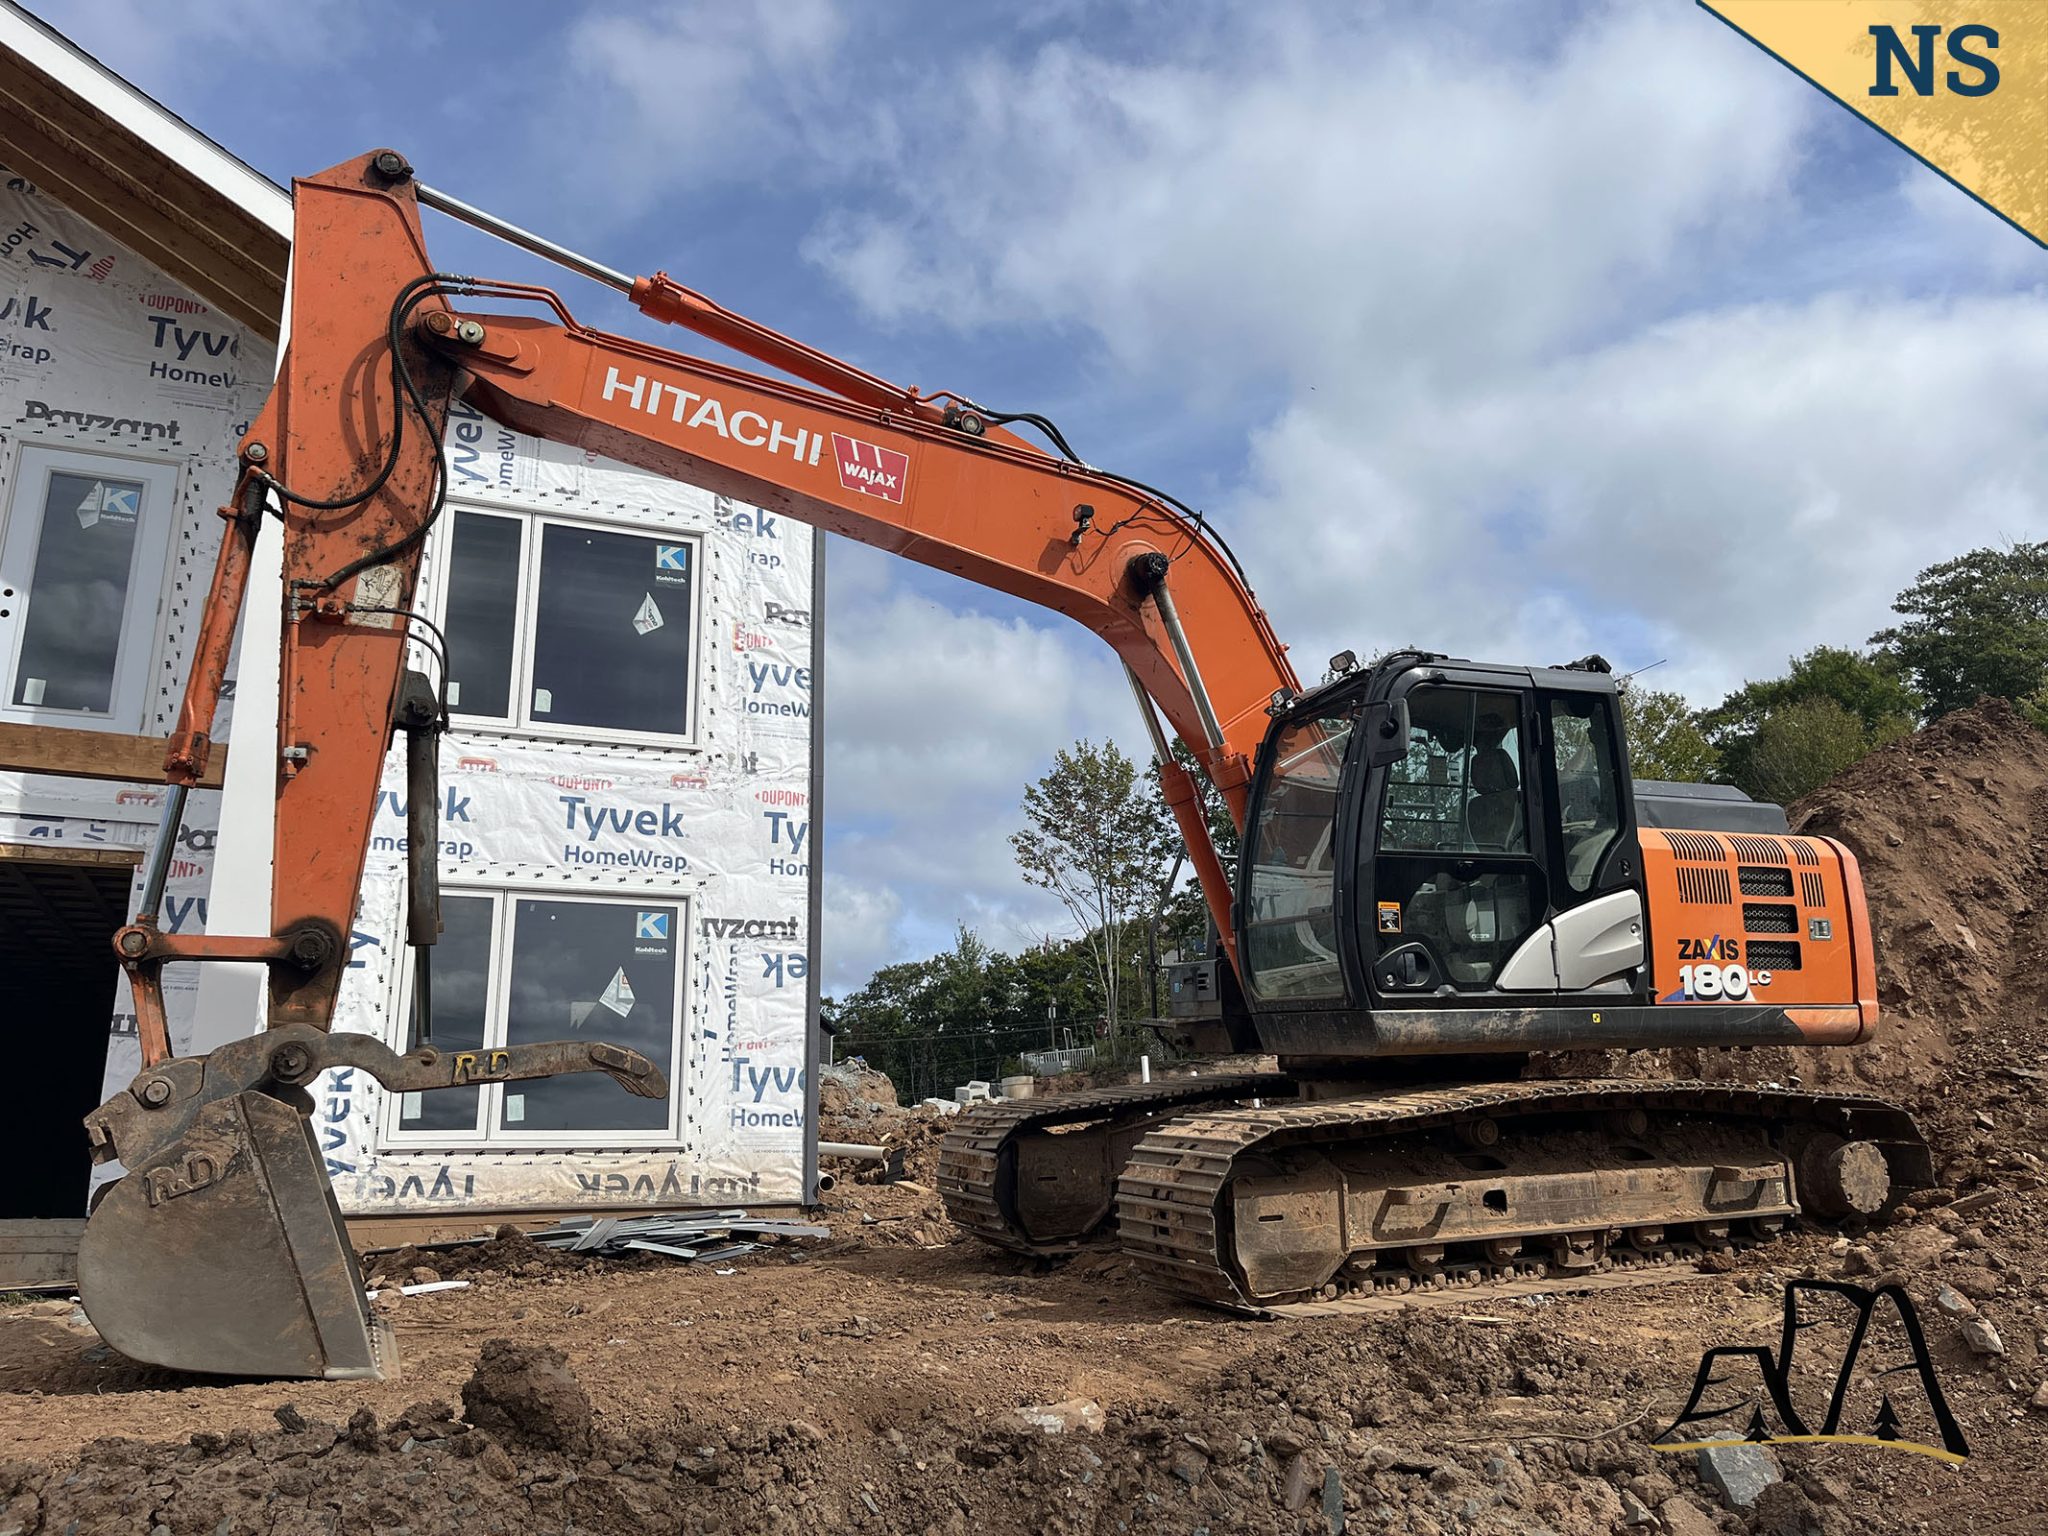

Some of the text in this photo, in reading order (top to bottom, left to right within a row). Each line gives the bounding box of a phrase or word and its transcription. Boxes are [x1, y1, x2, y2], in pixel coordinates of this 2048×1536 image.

[602, 366, 823, 467] HITACHI
[844, 461, 897, 489] WAJAX
[761, 789, 806, 807] DUPONT
[559, 795, 684, 842] Tyvek
[564, 845, 688, 873] HomeWrap
[1678, 934, 1739, 961] ZAXIS
[1679, 963, 1772, 1001] 180 LC
